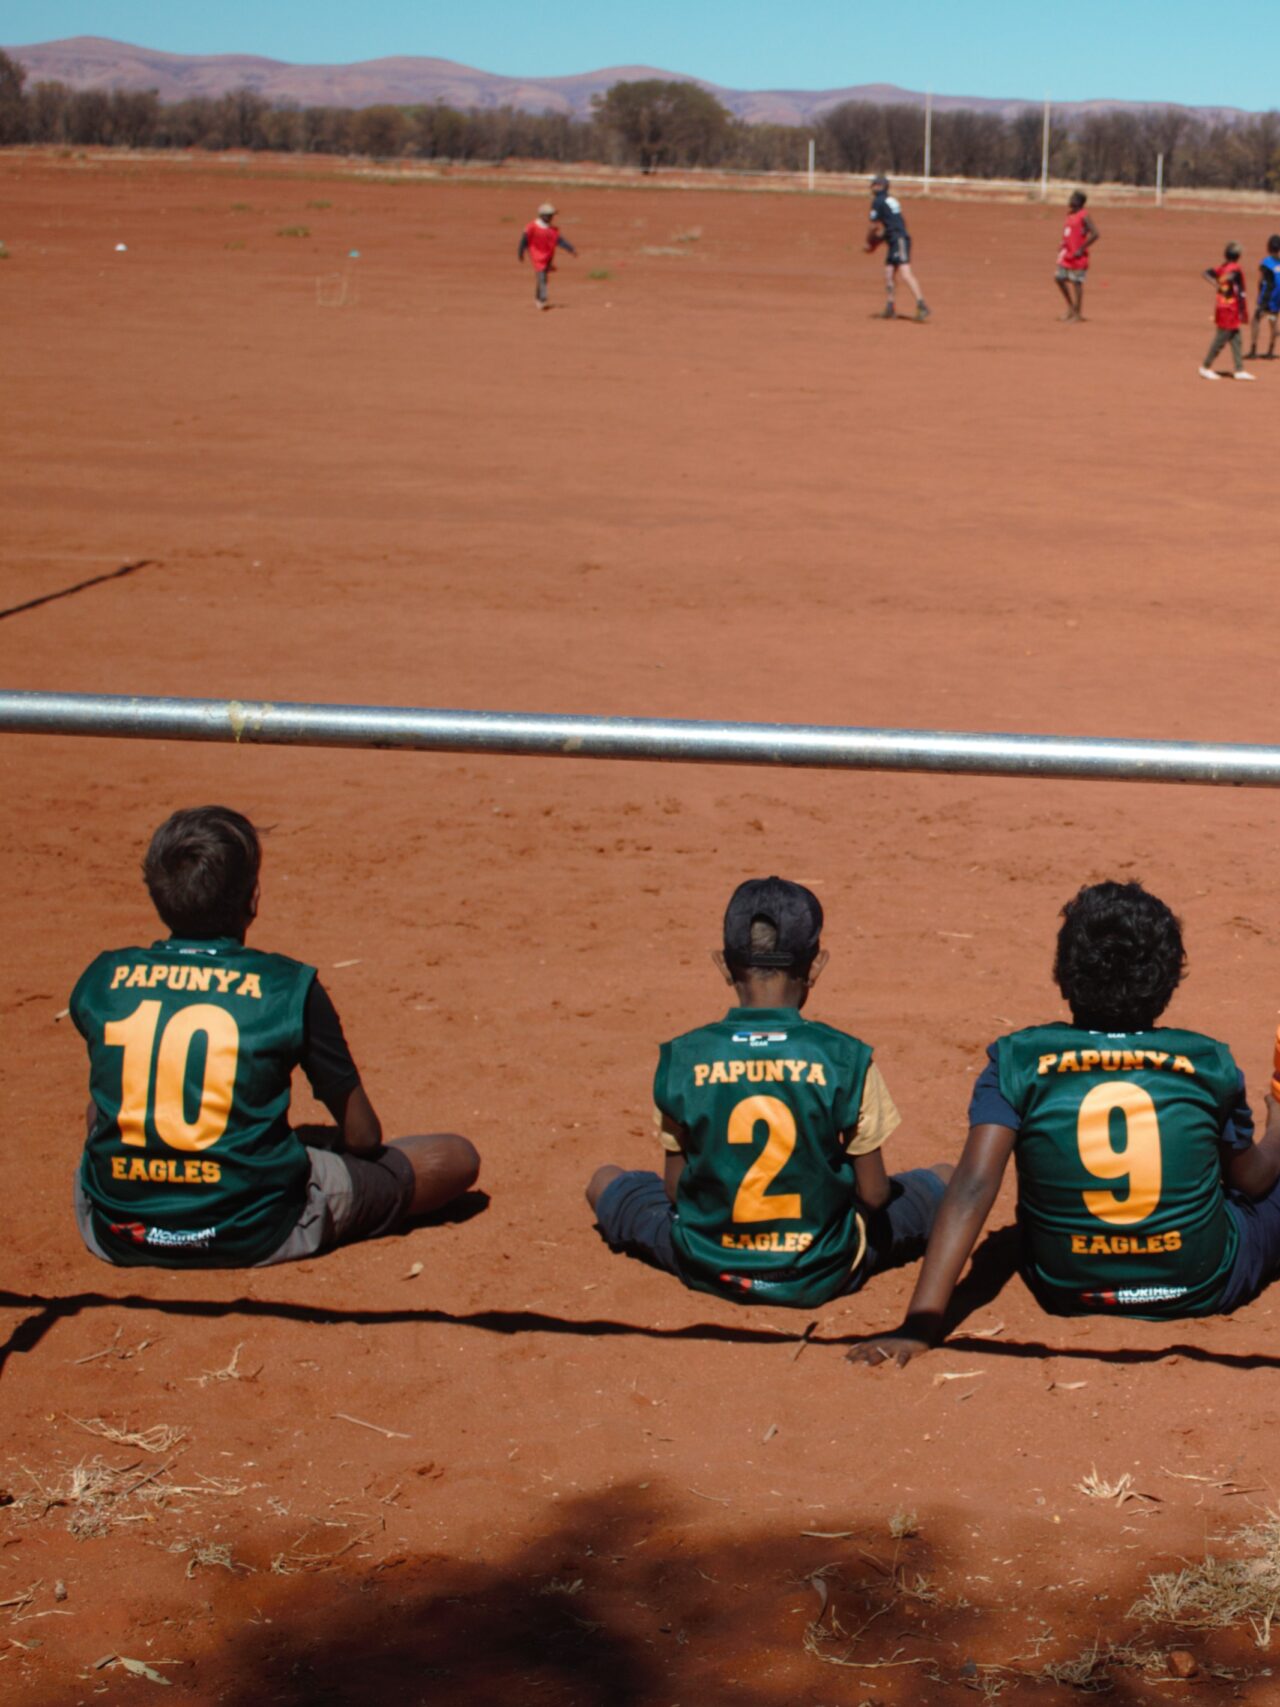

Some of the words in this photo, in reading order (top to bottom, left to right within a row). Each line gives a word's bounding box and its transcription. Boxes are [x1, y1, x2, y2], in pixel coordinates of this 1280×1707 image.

[111, 965, 262, 999] PAPUNYA
[104, 1000, 240, 1151] 10
[694, 1059, 827, 1086] PAPUNYA
[1037, 1050, 1196, 1075] PAPUNYA
[727, 1094, 802, 1223] 2
[1077, 1081, 1163, 1225] 9
[111, 1156, 222, 1184] EAGLES
[721, 1232, 813, 1252] EAGLES
[1071, 1231, 1183, 1255] EAGLES
